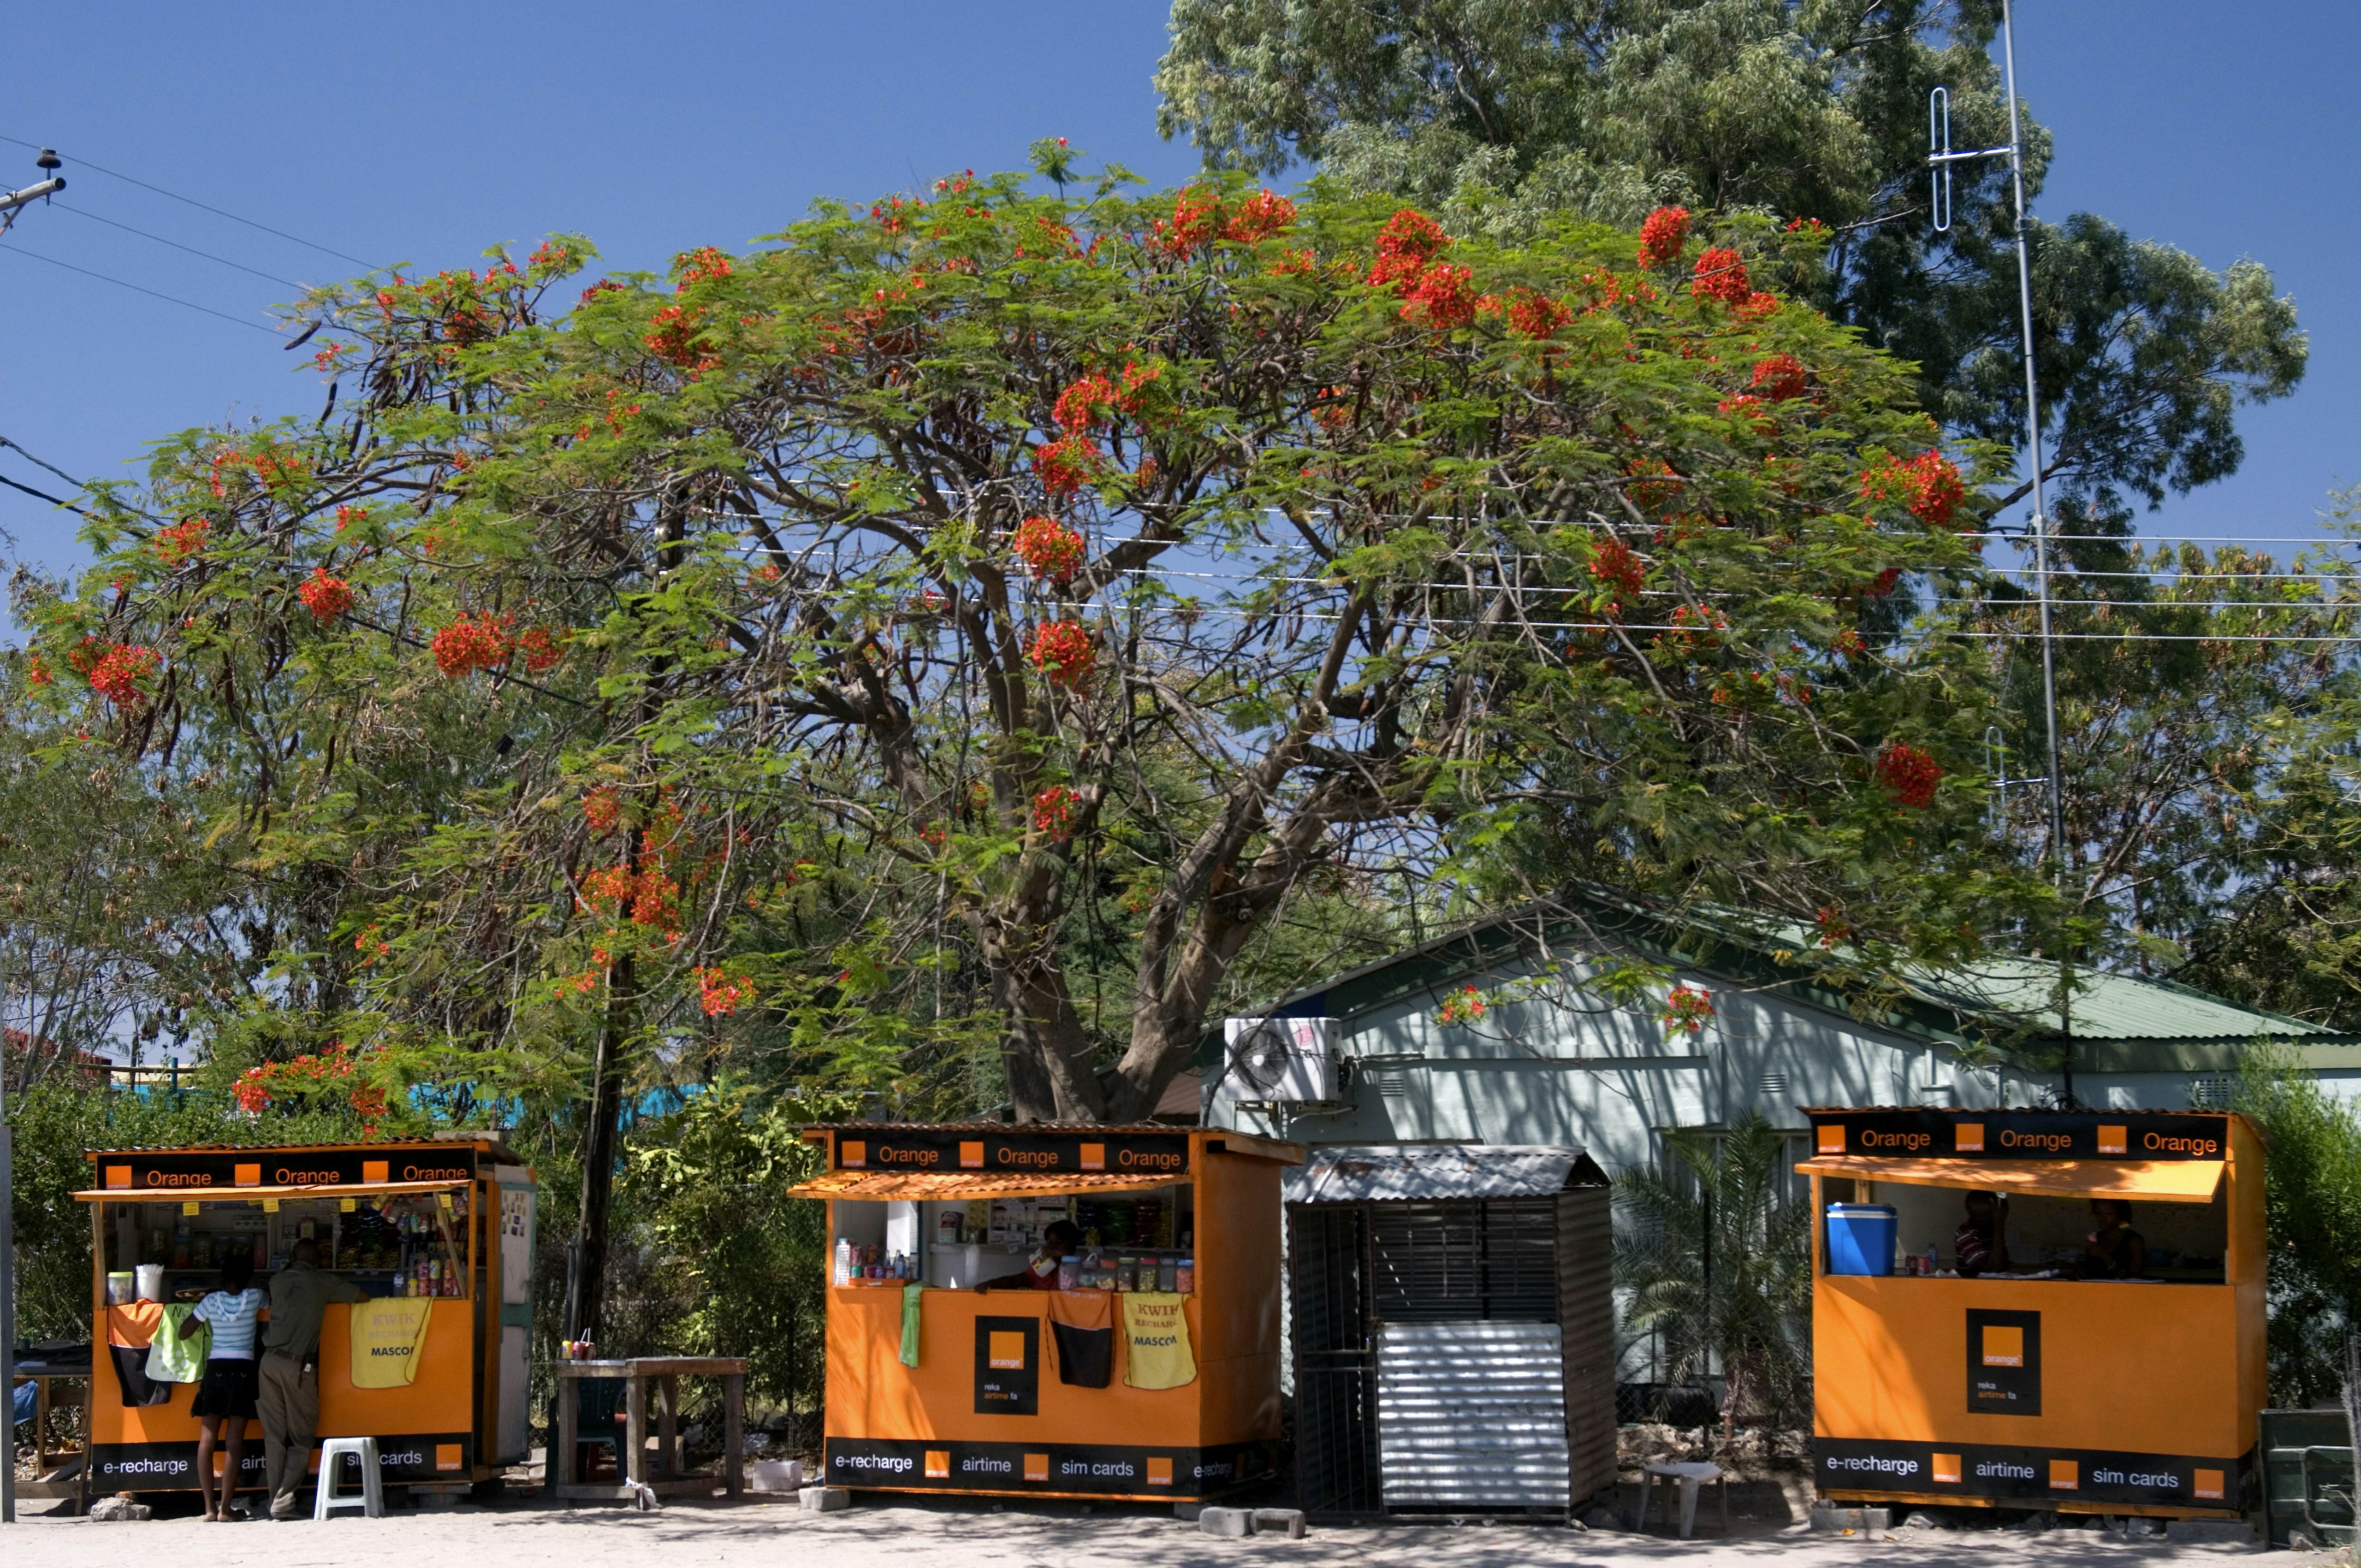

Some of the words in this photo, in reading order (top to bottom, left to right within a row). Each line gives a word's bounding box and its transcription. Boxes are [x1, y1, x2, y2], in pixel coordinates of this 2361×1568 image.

[1862, 1130, 1931, 1150] Orange
[2000, 1130, 2071, 1151] Orange
[2144, 1132, 2217, 1156] Orange
[879, 1146, 938, 1166] Orange
[998, 1148, 1058, 1168] Orange
[1119, 1149, 1180, 1170] Orange
[147, 1170, 212, 1187] Orange
[276, 1168, 339, 1184] Orange
[403, 1166, 467, 1180] Orange
[991, 1358, 1020, 1368] orange
[1984, 1355, 2019, 1365] orange
[1978, 1390, 2006, 1399] airtime
[242, 1455, 266, 1469] airt
[379, 1450, 422, 1465] cards
[836, 1454, 913, 1472] e-recharge
[962, 1456, 1011, 1472] airtime
[1827, 1456, 1918, 1475] e-recharge
[104, 1458, 188, 1475] e-recharge
[1062, 1460, 1087, 1474] sim
[1092, 1461, 1134, 1476] cards
[1976, 1461, 2035, 1479] airtime
[2093, 1467, 2124, 1484] sim
[2129, 1472, 2179, 1488] cards
